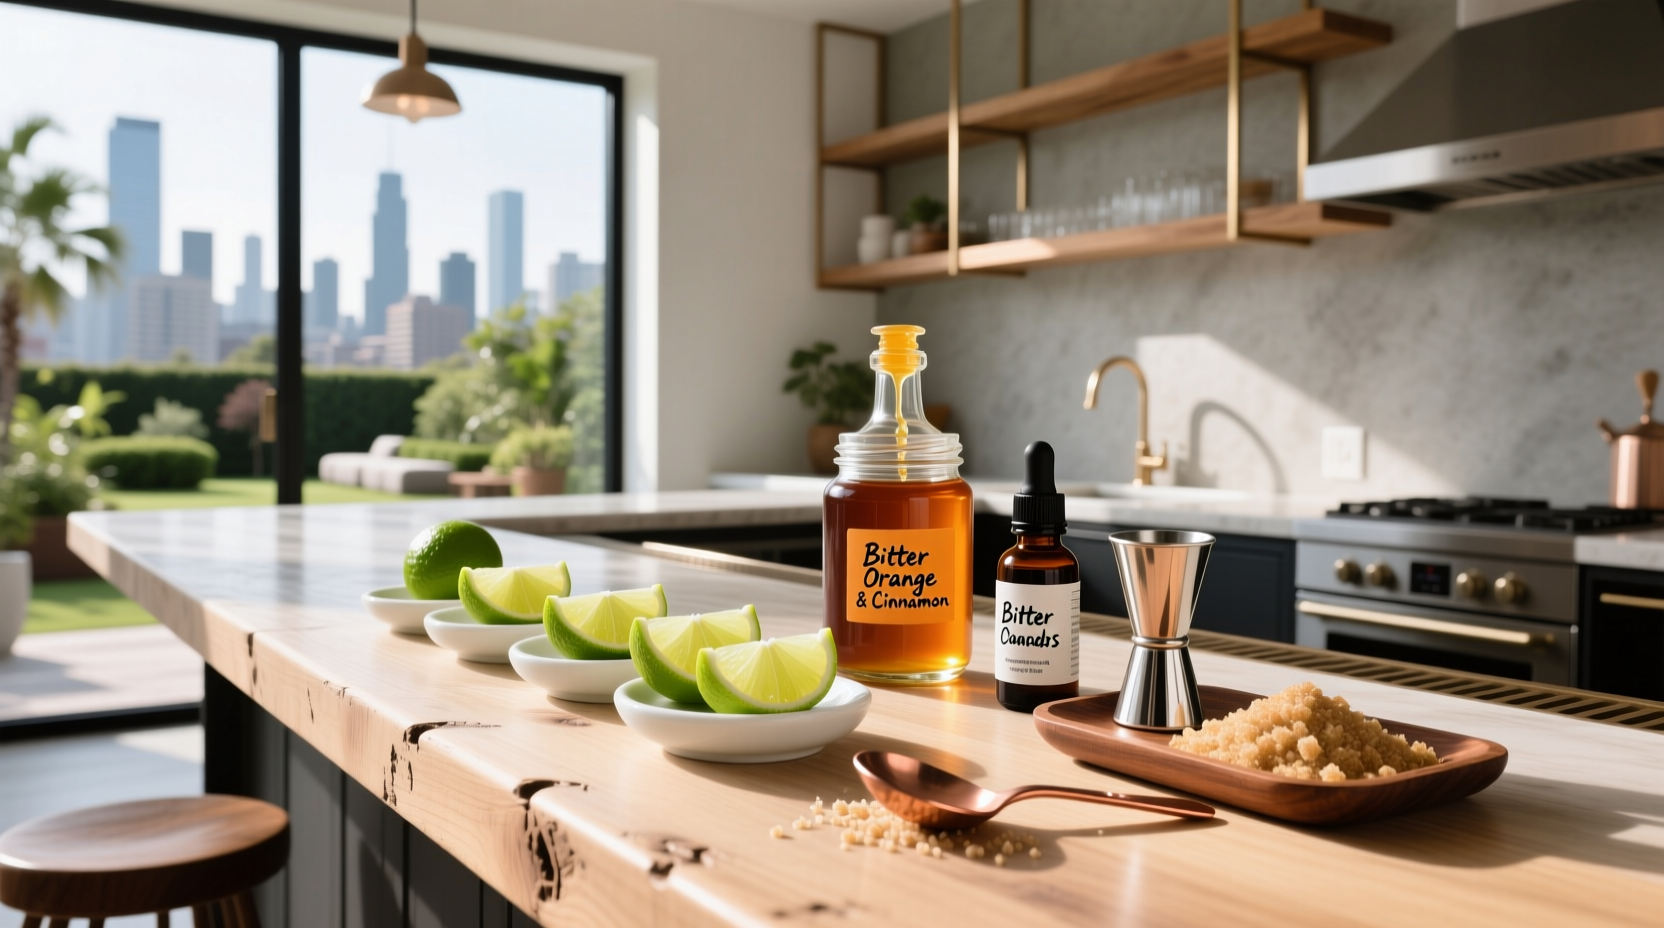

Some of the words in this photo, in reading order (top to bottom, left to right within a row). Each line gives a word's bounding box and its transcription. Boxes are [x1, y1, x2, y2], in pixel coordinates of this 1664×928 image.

[863, 542, 929, 567] Bitter
[863, 567, 937, 597] Orange
[856, 591, 867, 608] &
[872, 590, 949, 609] Cinnamon
[1002, 601, 1054, 625] Bitter
